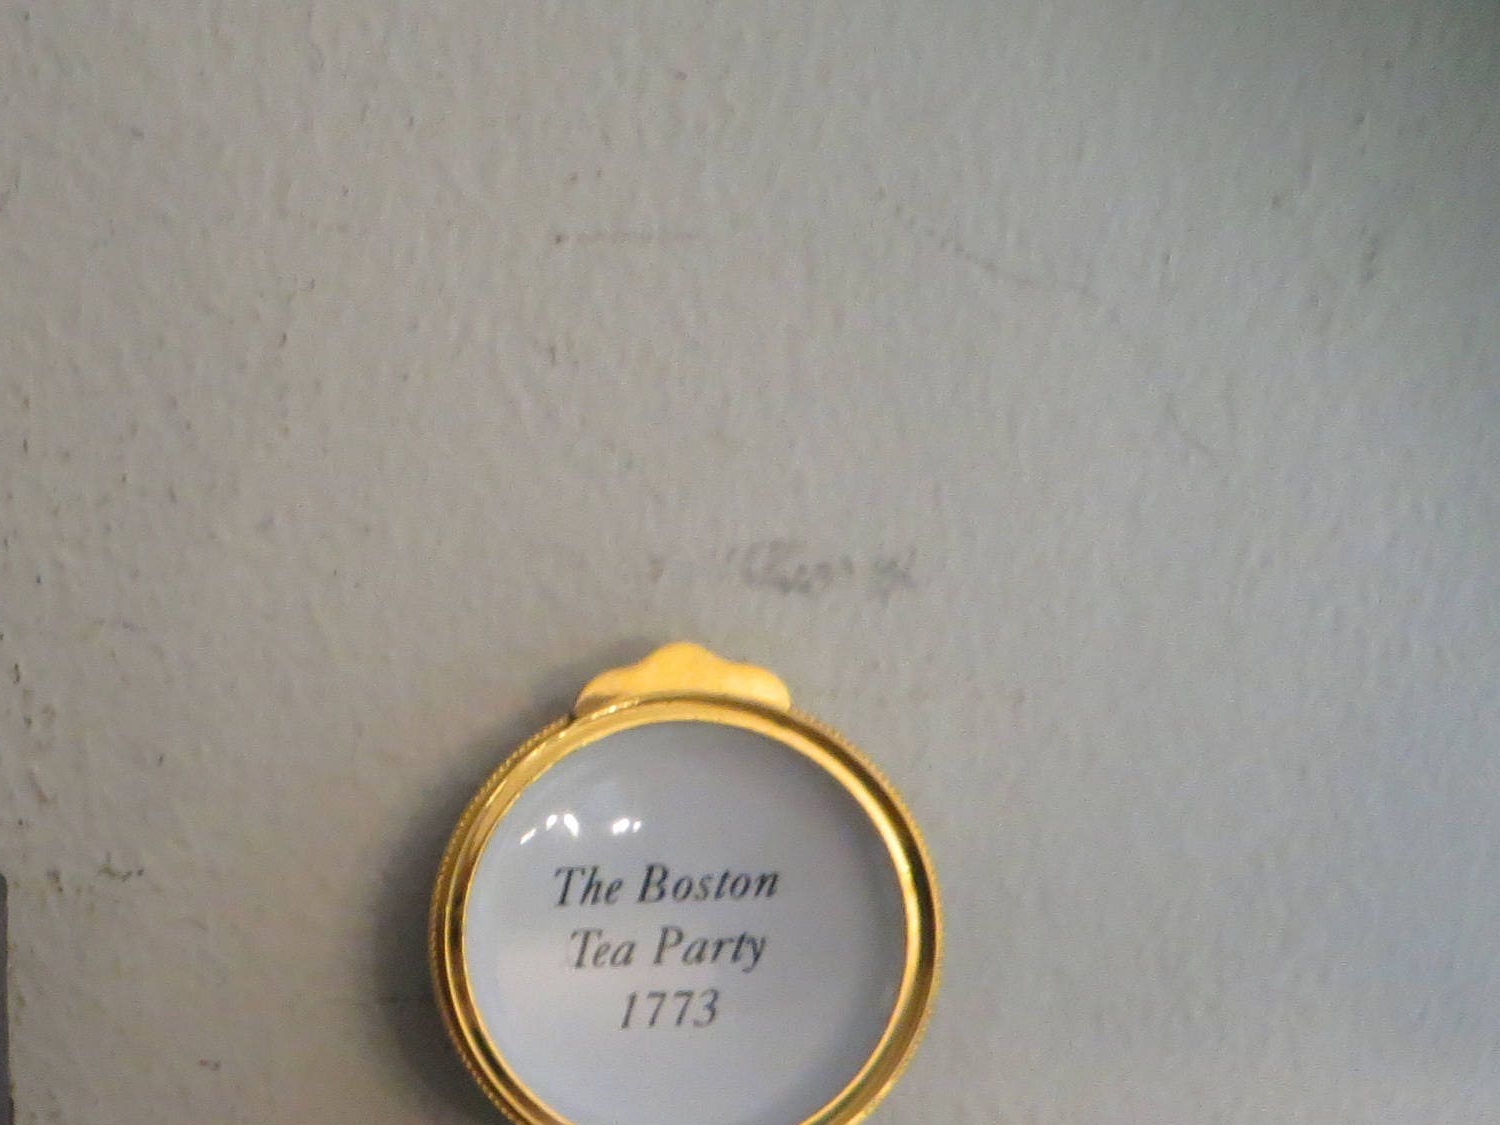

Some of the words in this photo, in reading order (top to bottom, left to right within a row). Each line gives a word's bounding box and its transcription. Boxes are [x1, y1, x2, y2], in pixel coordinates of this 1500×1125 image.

[554, 864, 624, 908] The
[636, 861, 780, 905] Boston
[570, 926, 637, 969] Tea
[652, 925, 767, 974] Party
[620, 988, 720, 1029] 1773
